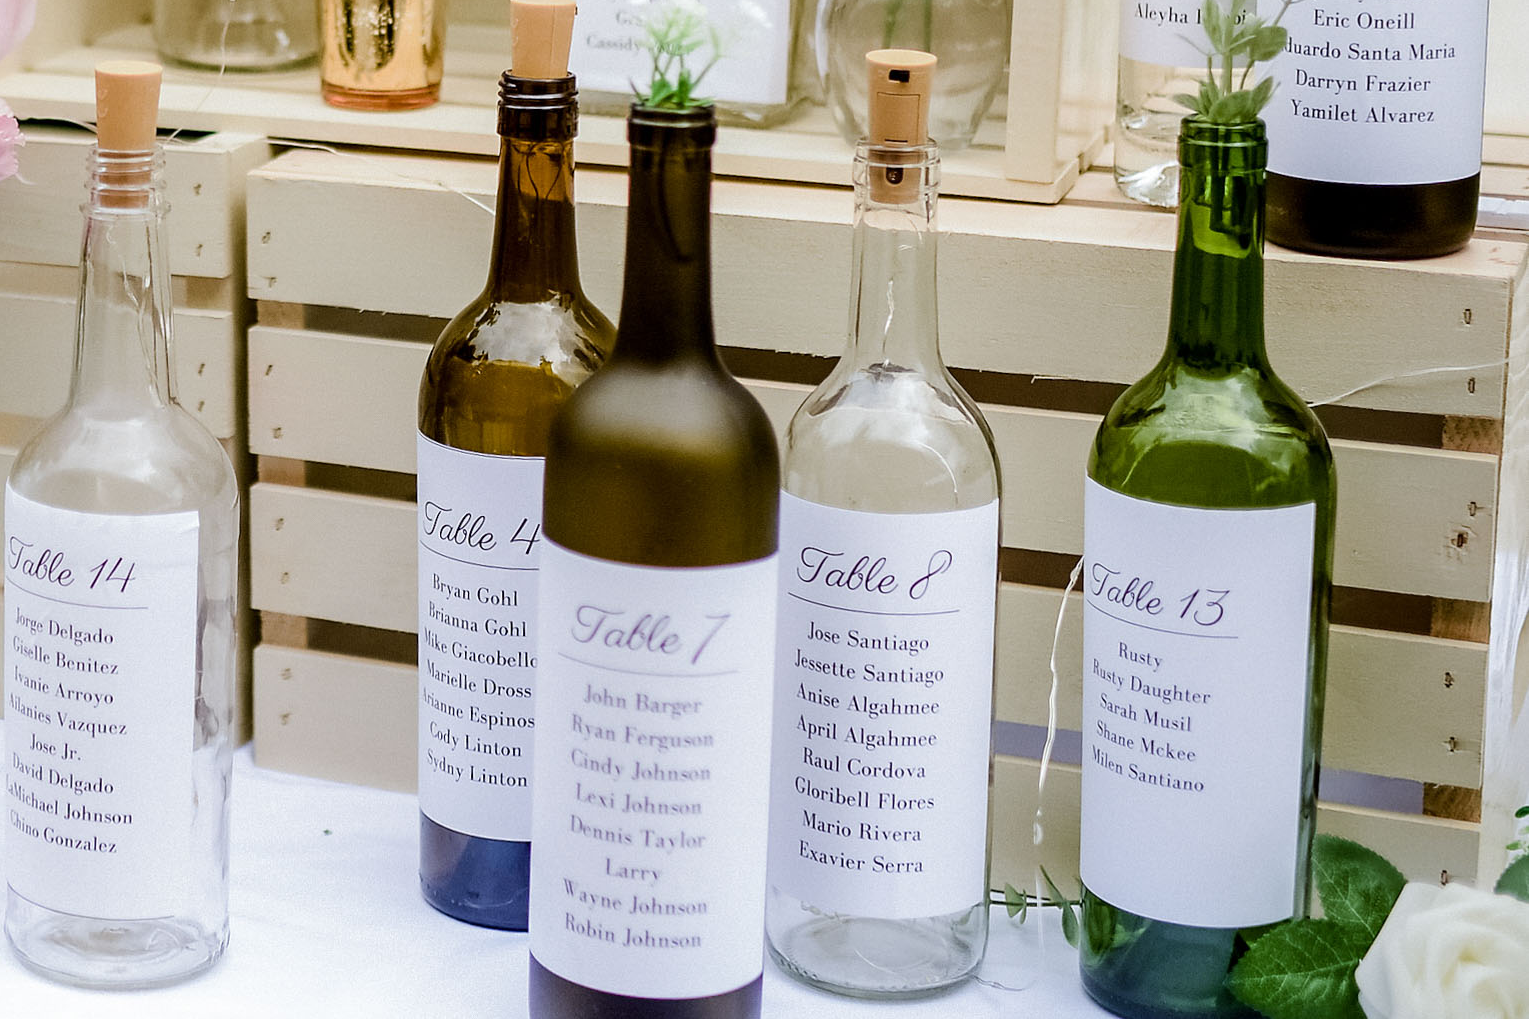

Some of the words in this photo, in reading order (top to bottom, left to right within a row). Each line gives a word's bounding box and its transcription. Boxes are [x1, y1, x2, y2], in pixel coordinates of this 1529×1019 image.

[1136, 3, 1188, 26] Aleyha
[1314, 9, 1349, 26] Eric
[1358, 12, 1415, 29] Oneill
[1348, 43, 1401, 60] Santa
[1409, 44, 1455, 60] Maria
[1296, 69, 1357, 95] Darryn
[1366, 76, 1431, 92] Frazier
[1291, 100, 1357, 123] Yamilet
[1366, 107, 1434, 124] Alvarez
[424, 501, 497, 551] Table
[510, 518, 541, 555] 4
[8, 536, 74, 587] Table
[90, 557, 136, 592] 14
[797, 546, 899, 594] Table
[909, 549, 952, 600] 8
[433, 573, 470, 600] Bryan
[477, 587, 518, 606] Gohl
[1091, 563, 1163, 616] Table
[1179, 589, 1230, 626] 13
[16, 607, 43, 636] Jorge
[49, 620, 113, 646] Delgado
[430, 601, 478, 632] Brianna
[485, 619, 526, 637] Gohl
[571, 604, 683, 656] Table
[689, 613, 731, 665] 7
[13, 636, 50, 664] Giselle
[56, 652, 118, 675] Benitez
[425, 627, 447, 654] Mike
[807, 622, 840, 645] Jose
[847, 630, 929, 656] Santiago
[1119, 642, 1163, 672] Rusty
[15, 665, 49, 694] Ivanie
[55, 683, 113, 708] Arroyo
[427, 659, 476, 692] Marielle
[794, 649, 856, 680] Jessette
[863, 665, 944, 691] Santiago
[1093, 658, 1124, 691] Rusty
[1131, 675, 1211, 704] Daughter
[424, 686, 463, 718] Arianne
[584, 684, 626, 709] John
[636, 693, 701, 717] Barger
[797, 683, 840, 709] Anise
[847, 696, 939, 719] Algahmee
[1100, 692, 1137, 721] Sarah
[1144, 709, 1191, 732] Musil
[57, 712, 127, 738] Vazquez
[430, 721, 458, 751] Cody
[466, 735, 522, 757] Linton
[572, 713, 615, 741] Ryan
[625, 726, 714, 752] Ferguson
[797, 715, 836, 742] April
[844, 727, 937, 751] Algahmee
[1097, 719, 1134, 749] Shane
[1141, 737, 1196, 761] Mckee
[30, 734, 56, 755] Jose
[62, 743, 81, 760] Jr.
[571, 749, 621, 781] Cindy
[632, 762, 710, 781] Johnson
[802, 747, 840, 773] Raul
[847, 758, 926, 778] Cordova
[13, 752, 43, 780] David
[49, 769, 113, 795] Delgado
[427, 748, 463, 782] Sydny
[470, 766, 527, 787] Linton
[1092, 744, 1123, 775] Milen
[1128, 763, 1204, 792] Santiano
[576, 783, 614, 808] Lexi
[622, 794, 701, 815] Johnson
[795, 776, 869, 808] Gloribell
[878, 793, 934, 811] Flores
[11, 810, 39, 837] Chino
[44, 827, 117, 853] Gonzalez
[64, 803, 132, 824] Johnson
[802, 811, 851, 838] Mario
[859, 823, 921, 843] Rivera
[570, 815, 632, 845] Dennis
[641, 829, 706, 854] Taylor
[606, 858, 661, 885] Larry
[799, 840, 865, 872] Exavier
[872, 856, 923, 874] Serra
[564, 878, 621, 911] Wayne
[629, 895, 707, 915] Johnson
[565, 912, 615, 943] Robin
[622, 928, 701, 948] Johnson
